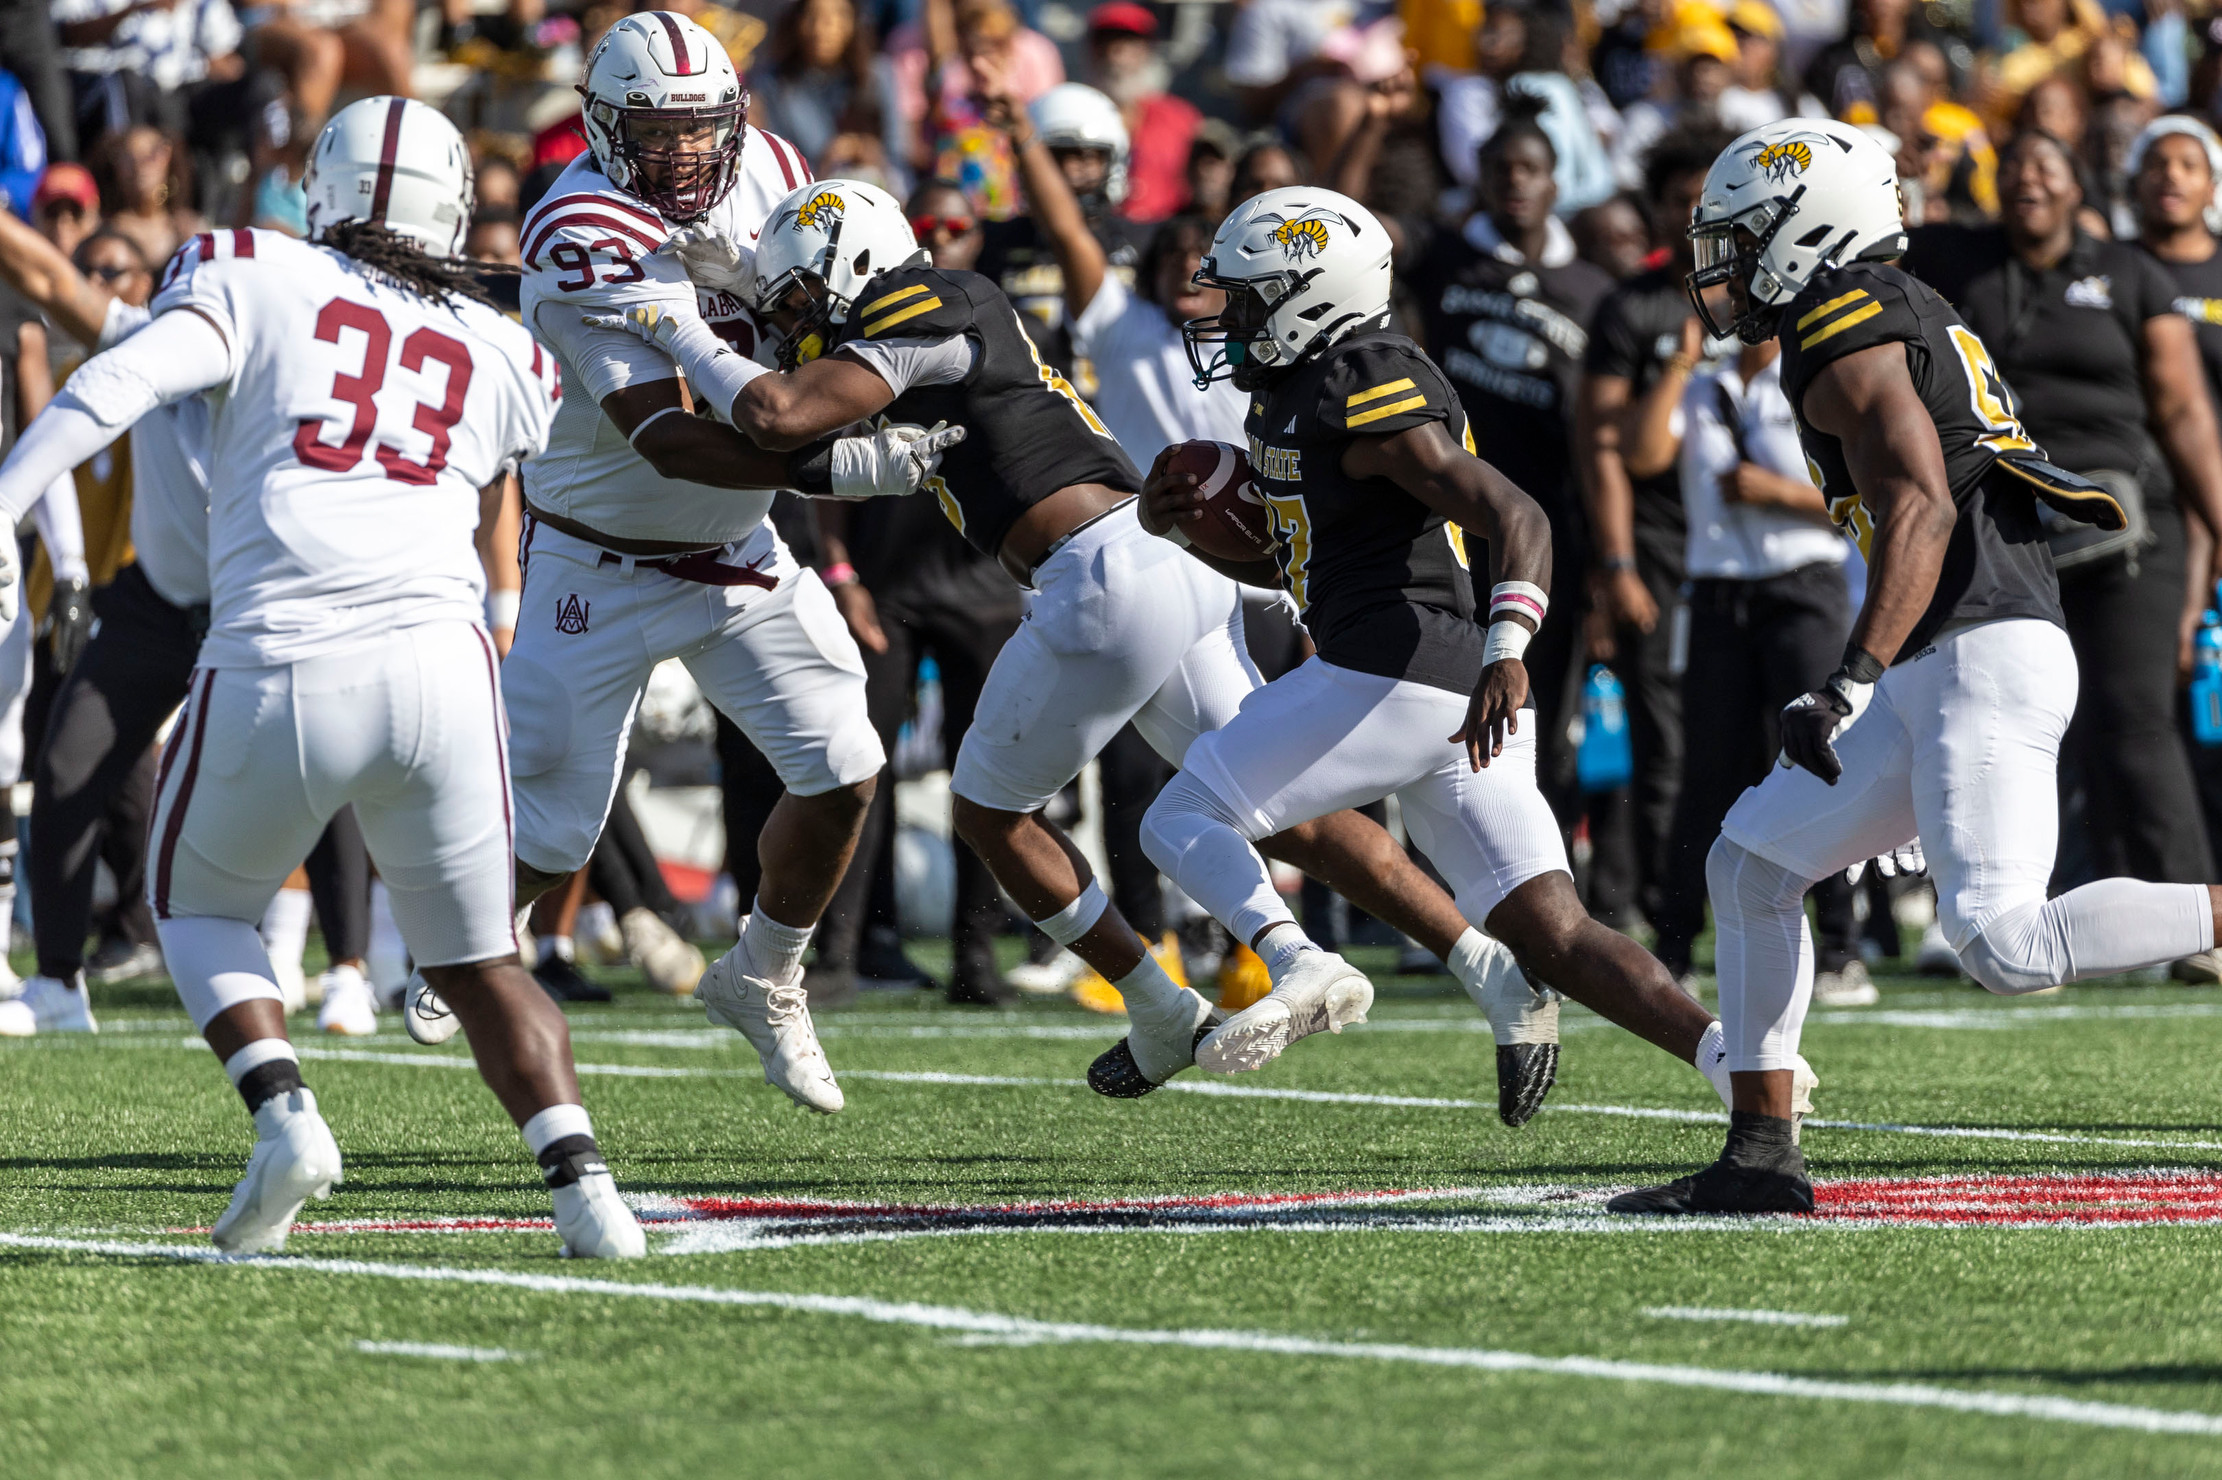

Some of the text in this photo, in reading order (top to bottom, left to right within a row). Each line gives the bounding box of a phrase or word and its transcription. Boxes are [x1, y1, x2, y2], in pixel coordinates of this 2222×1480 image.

[671, 93, 706, 102] BULLDOGS
[550, 237, 646, 292] 93
[696, 293, 743, 319] LABA
[293, 296, 474, 486] 33
[1263, 445, 1302, 481] STATE
[1225, 508, 1262, 544] VAPOR ELITE
[1253, 482, 1313, 617] 7
